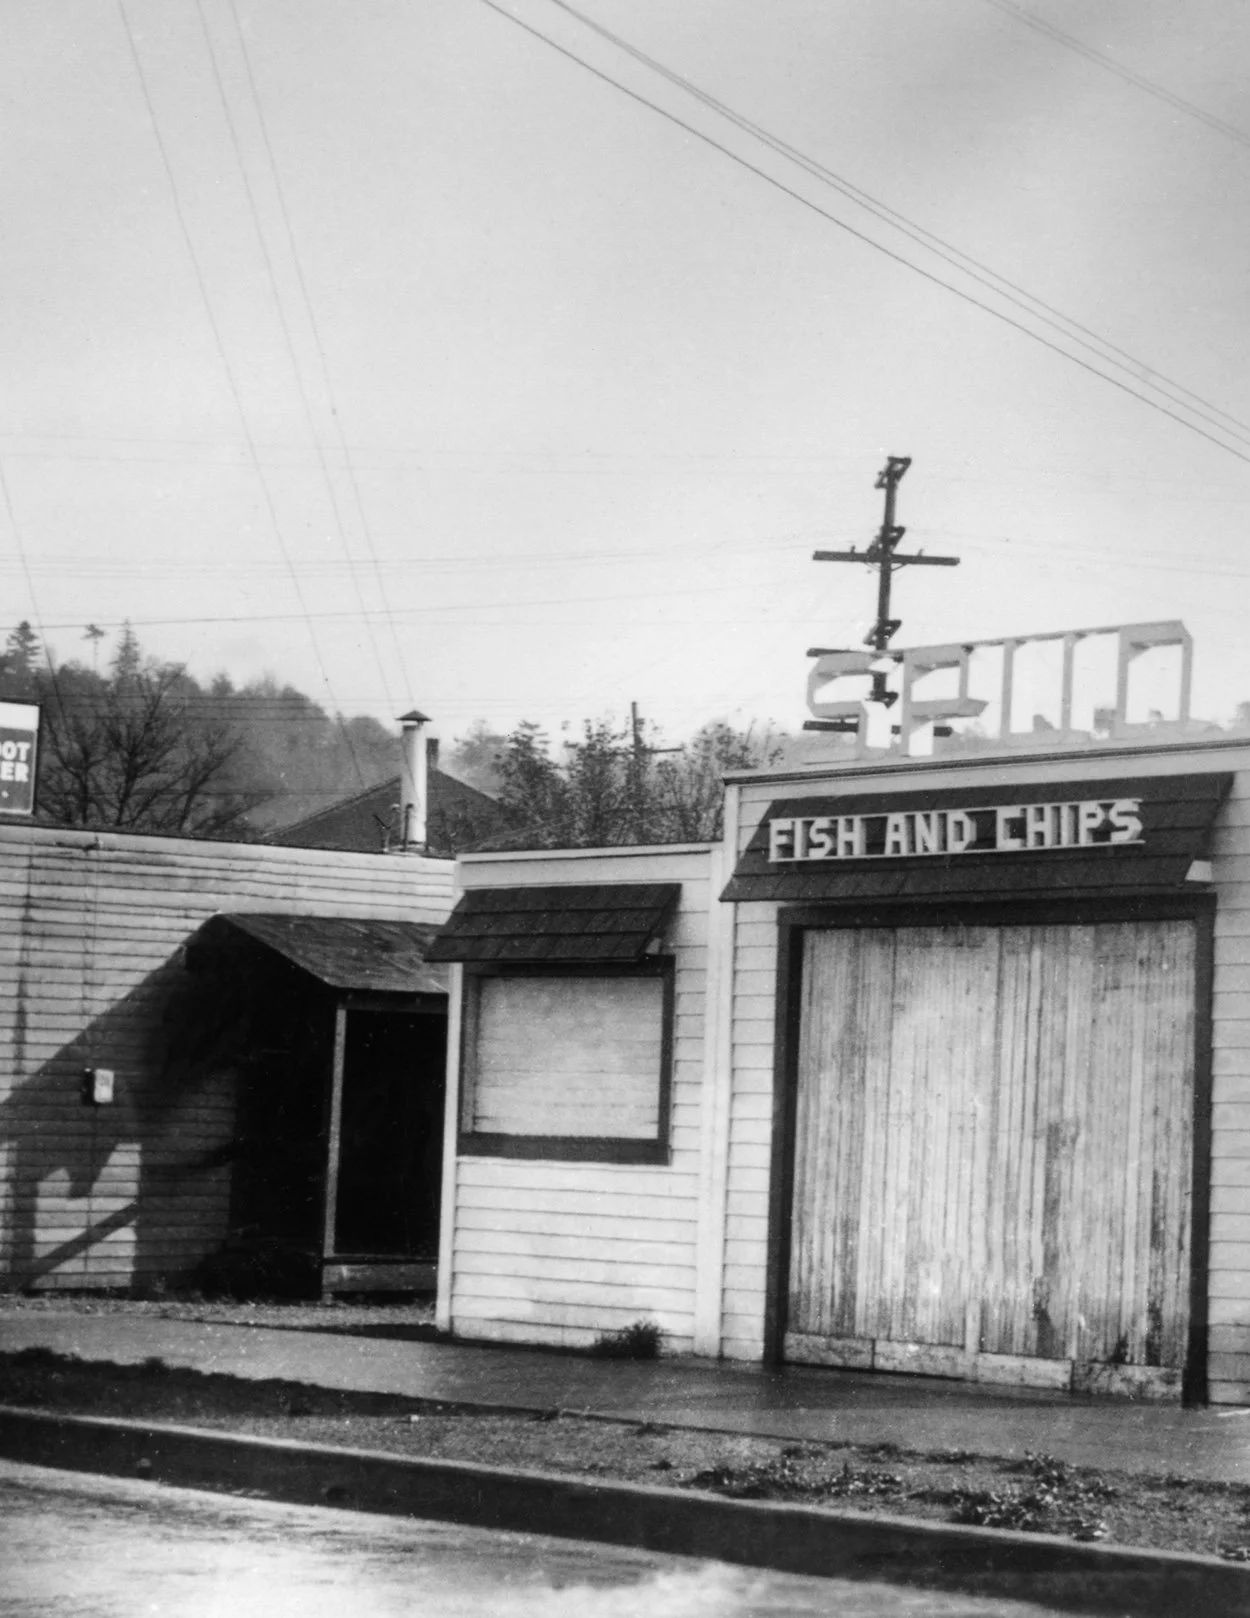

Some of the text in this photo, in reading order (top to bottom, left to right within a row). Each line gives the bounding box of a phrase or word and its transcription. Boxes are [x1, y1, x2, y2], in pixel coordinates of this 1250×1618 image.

[0, 741, 32, 762] OT
[769, 799, 1144, 861] FISH AND CHIPS
